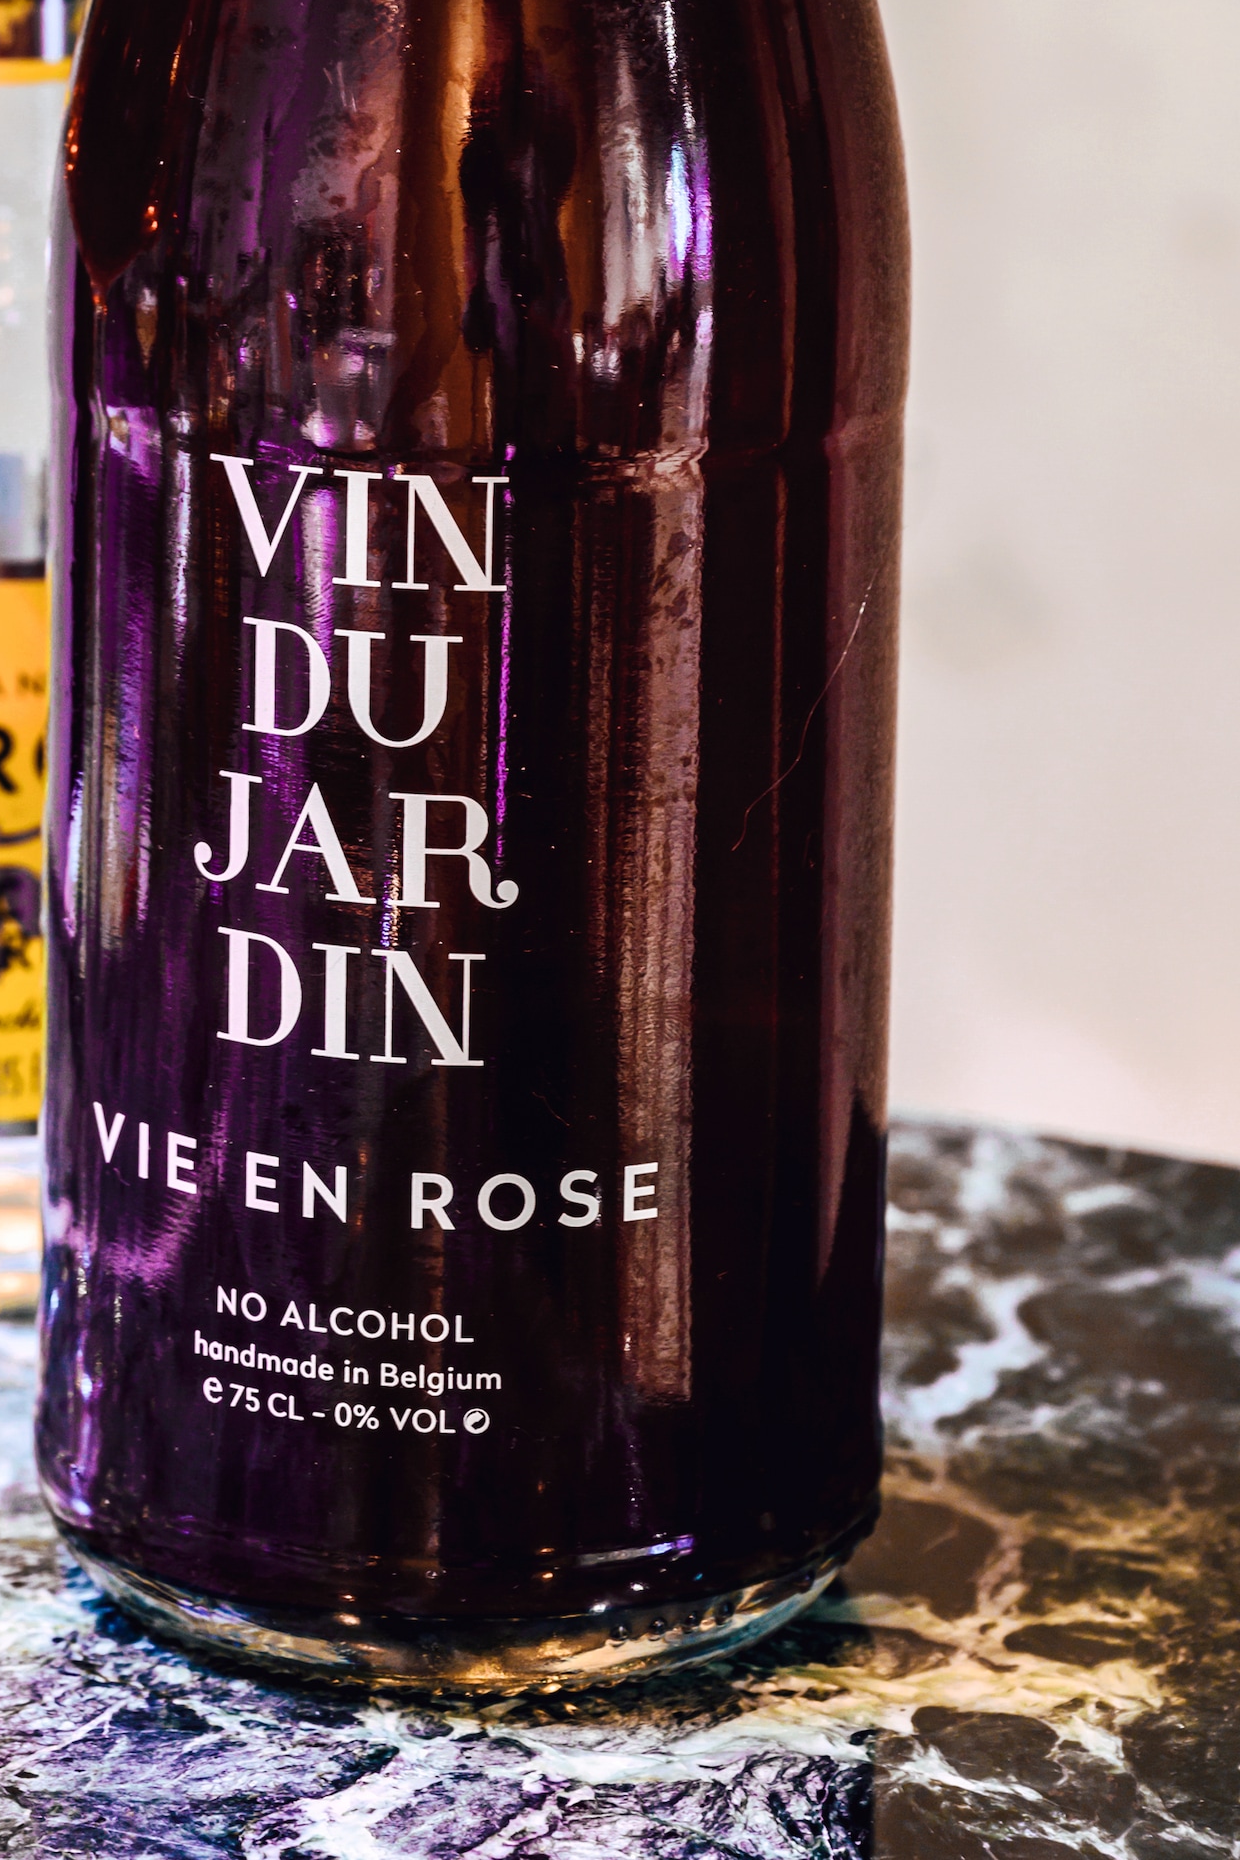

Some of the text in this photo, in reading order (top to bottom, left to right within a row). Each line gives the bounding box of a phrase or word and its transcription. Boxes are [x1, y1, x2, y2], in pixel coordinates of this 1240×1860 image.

[210, 453, 510, 592] VIN
[241, 616, 463, 748] DU
[194, 770, 519, 910] JAR
[216, 926, 486, 1066] DIN
[92, 1101, 659, 1231] VIE EN ROSE
[194, 1329, 502, 1397] handmade in Belgium
[217, 1285, 475, 1343] NO ALCOHOL
[229, 1383, 260, 1413] 75
[267, 1392, 305, 1421] CL
[334, 1402, 380, 1430] 0%
[389, 1407, 456, 1434] VOL
